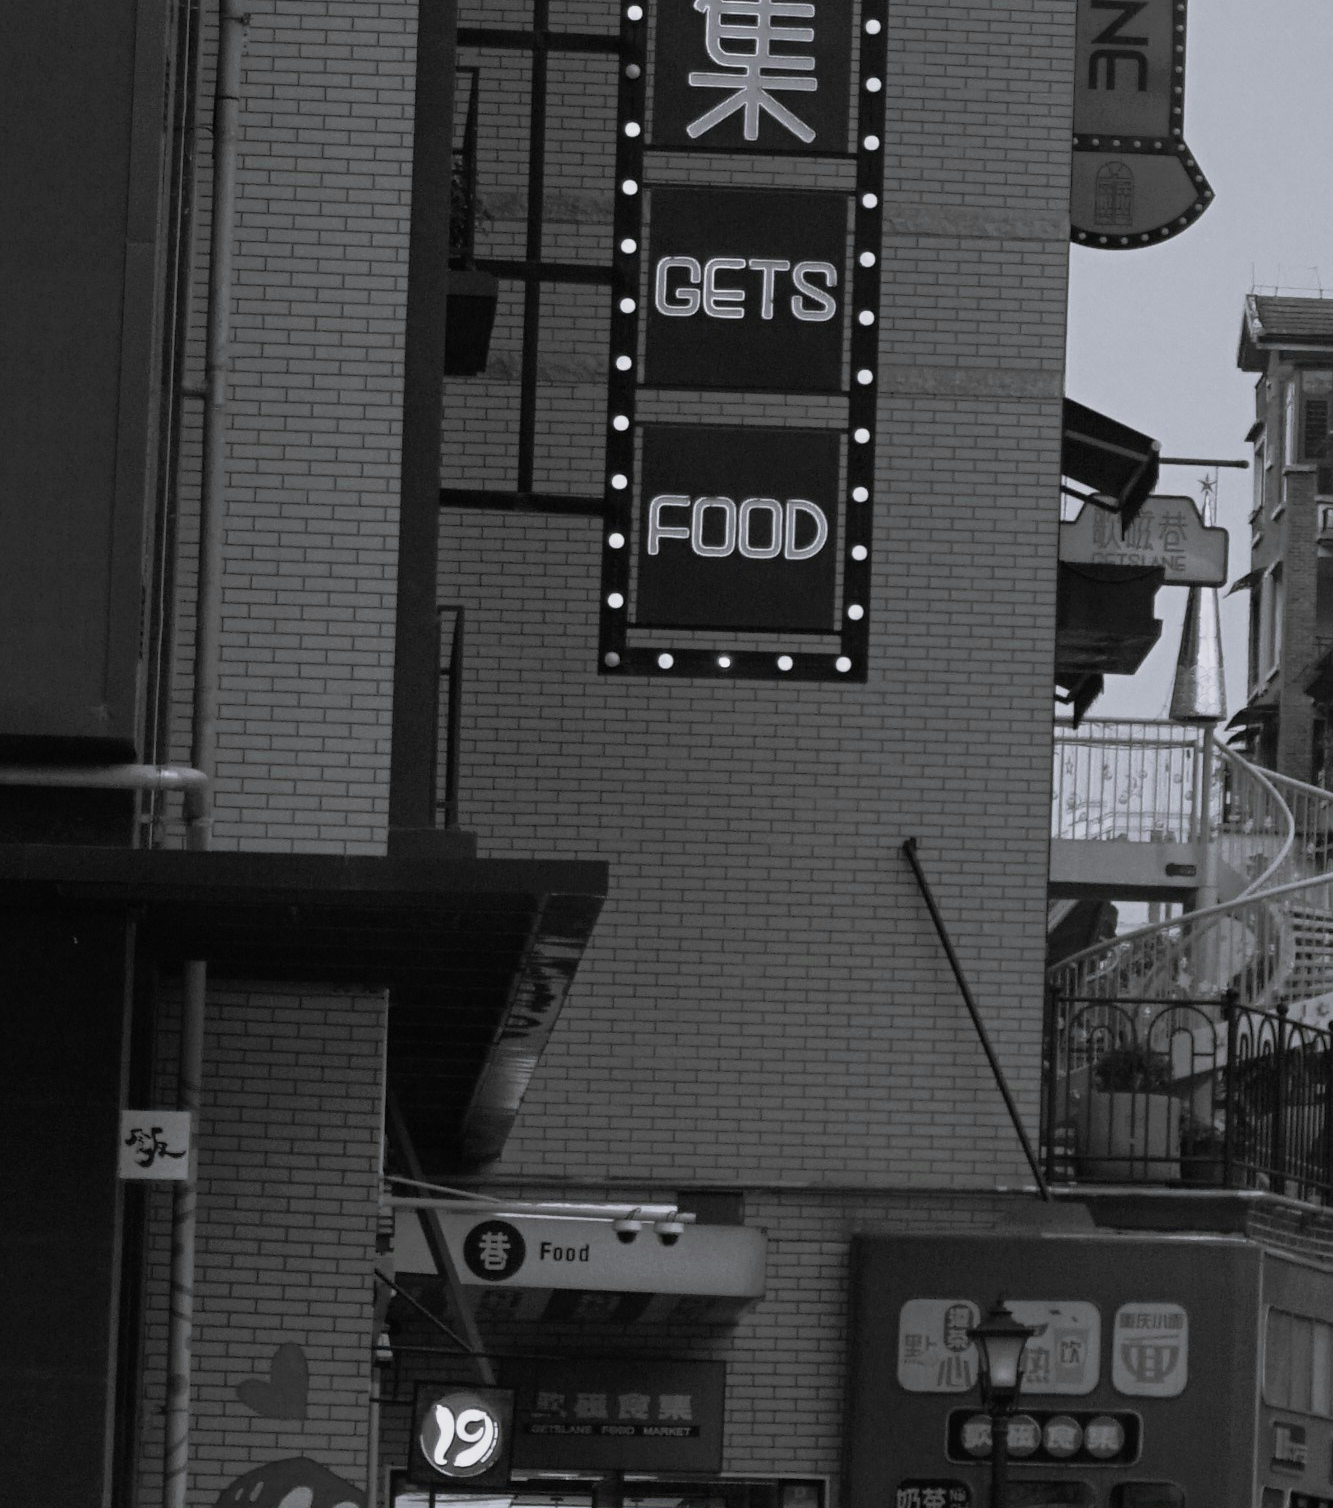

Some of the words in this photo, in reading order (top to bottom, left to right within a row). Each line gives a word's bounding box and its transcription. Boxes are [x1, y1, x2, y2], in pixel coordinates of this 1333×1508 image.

[653, 255, 838, 322] GETS
[646, 494, 829, 560] FOOD
[540, 1242, 590, 1262] Food
[643, 1426, 691, 1436] MARKET
